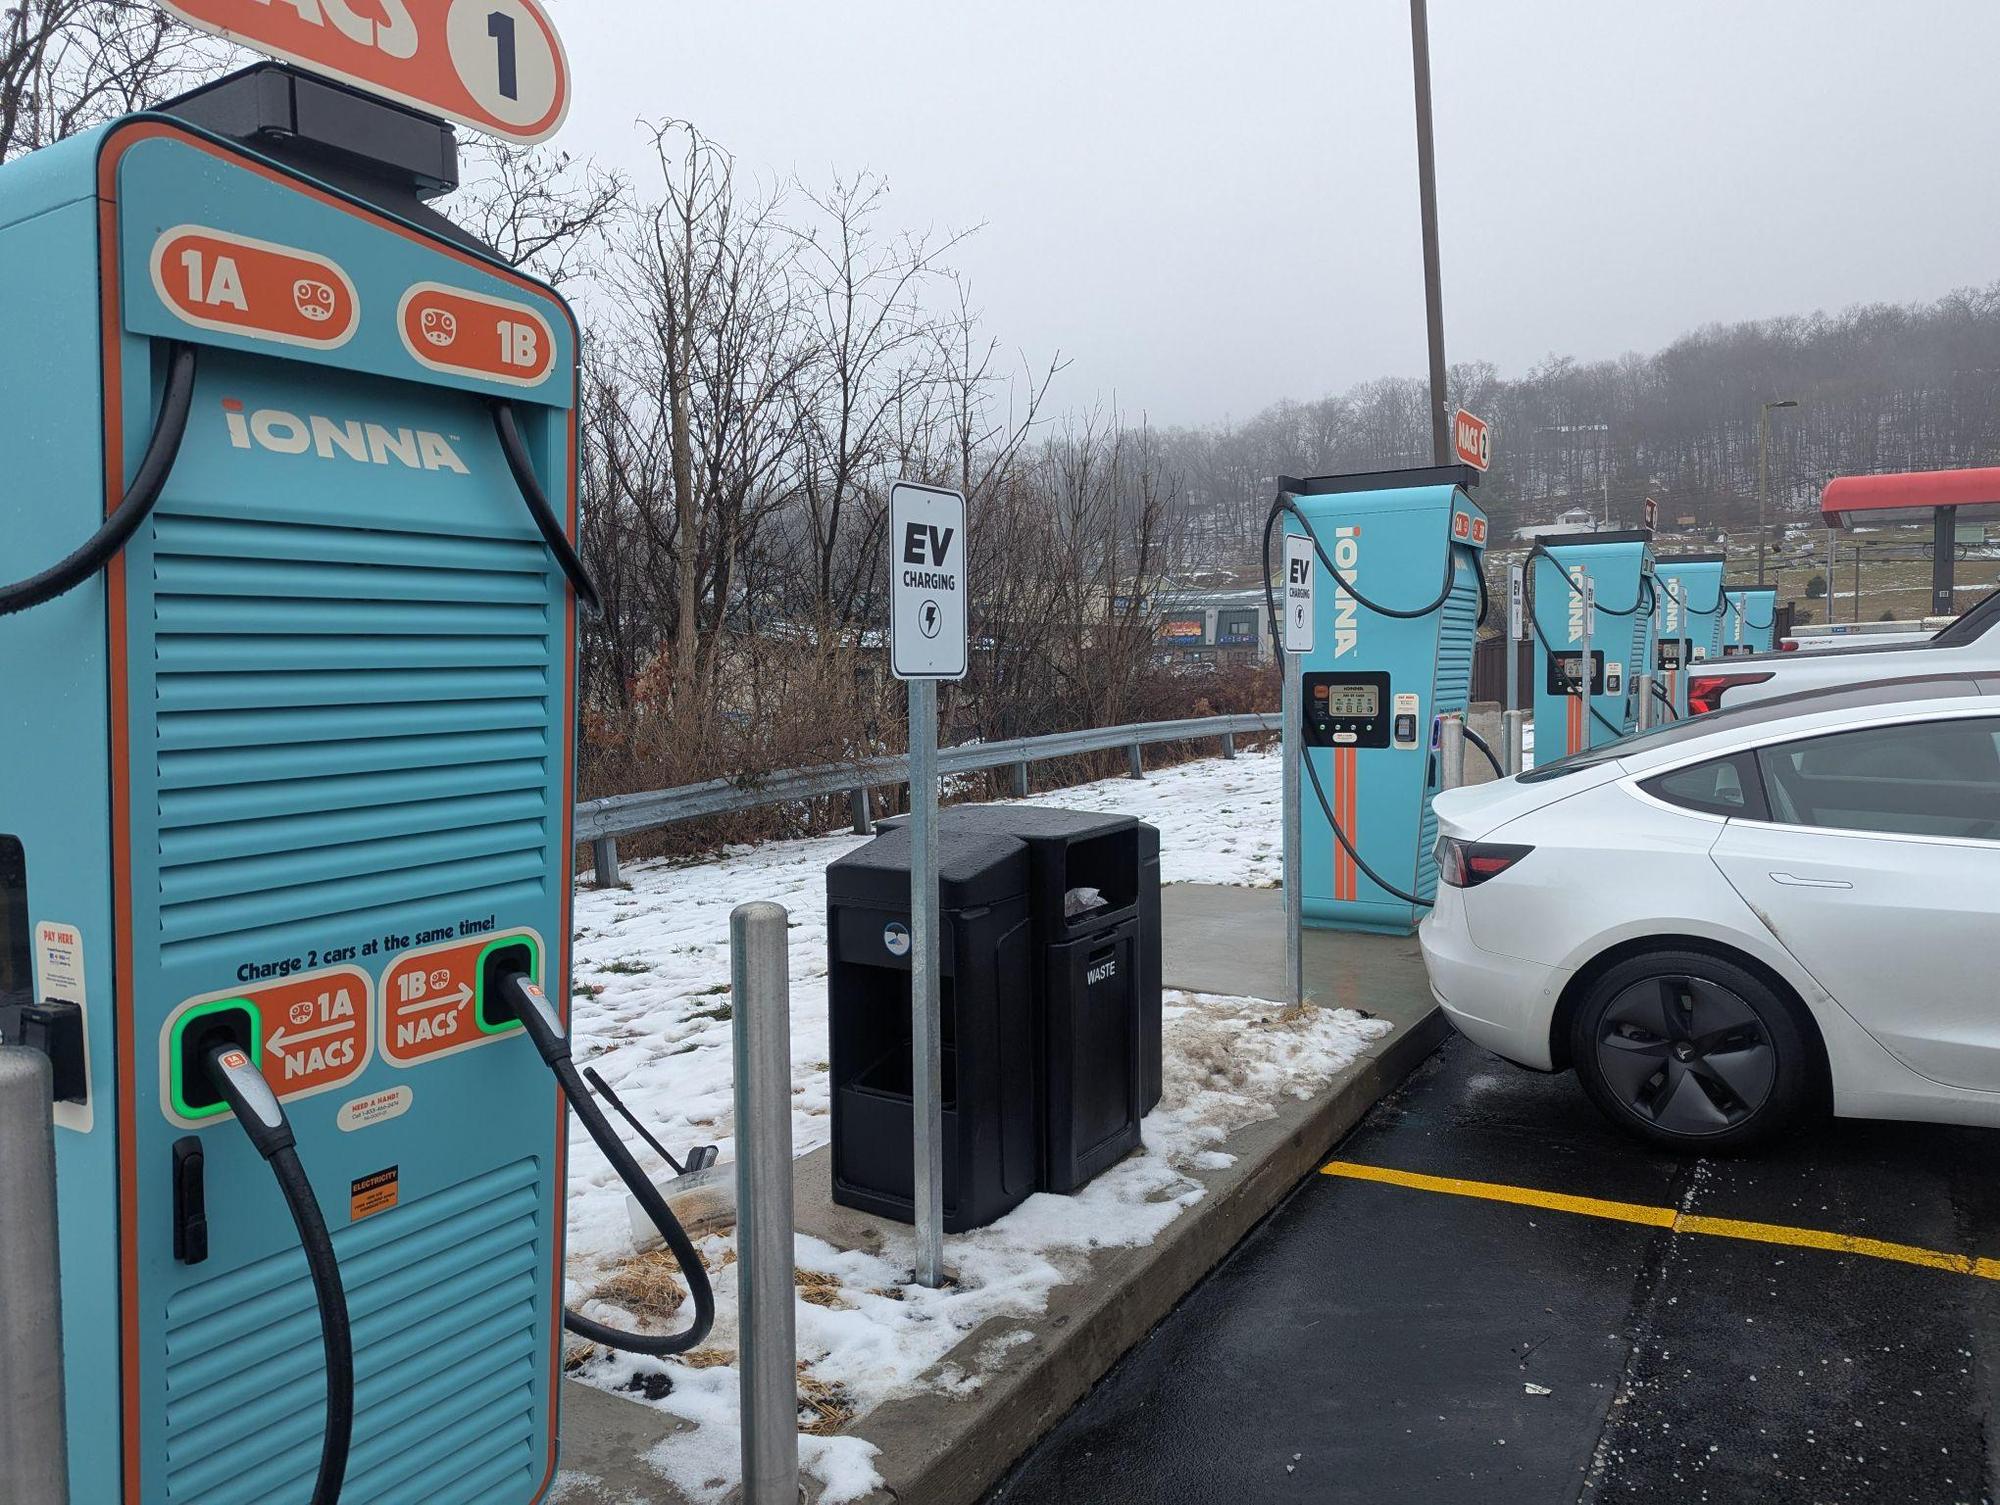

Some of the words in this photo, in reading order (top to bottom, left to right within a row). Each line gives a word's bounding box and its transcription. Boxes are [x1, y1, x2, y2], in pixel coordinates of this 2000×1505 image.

[488, 11, 518, 101] 1
[181, 249, 248, 312] 1A
[496, 320, 537, 367] 1B
[1459, 420, 1478, 455] NACS
[903, 521, 954, 567] EV
[903, 570, 955, 591] CHARGING
[1290, 558, 1310, 584] EV
[43, 930, 55, 942] PAY
[57, 931, 74, 945] HERE
[237, 958, 302, 982] Charge
[308, 950, 318, 967] 2
[323, 946, 356, 964] cars
[362, 938, 378, 956] at
[384, 935, 410, 952] the
[415, 925, 454, 946] same
[459, 914, 495, 936] time!
[397, 971, 426, 1001] 1B
[1087, 961, 1115, 985] WASTE
[317, 988, 354, 1022] 1A
[397, 1009, 458, 1048] NACS
[284, 1037, 355, 1080] NACS
[352, 1102, 369, 1112] NEED
[377, 1092, 399, 1104] HAND?
[353, 1170, 397, 1192] ELECTRICITY
